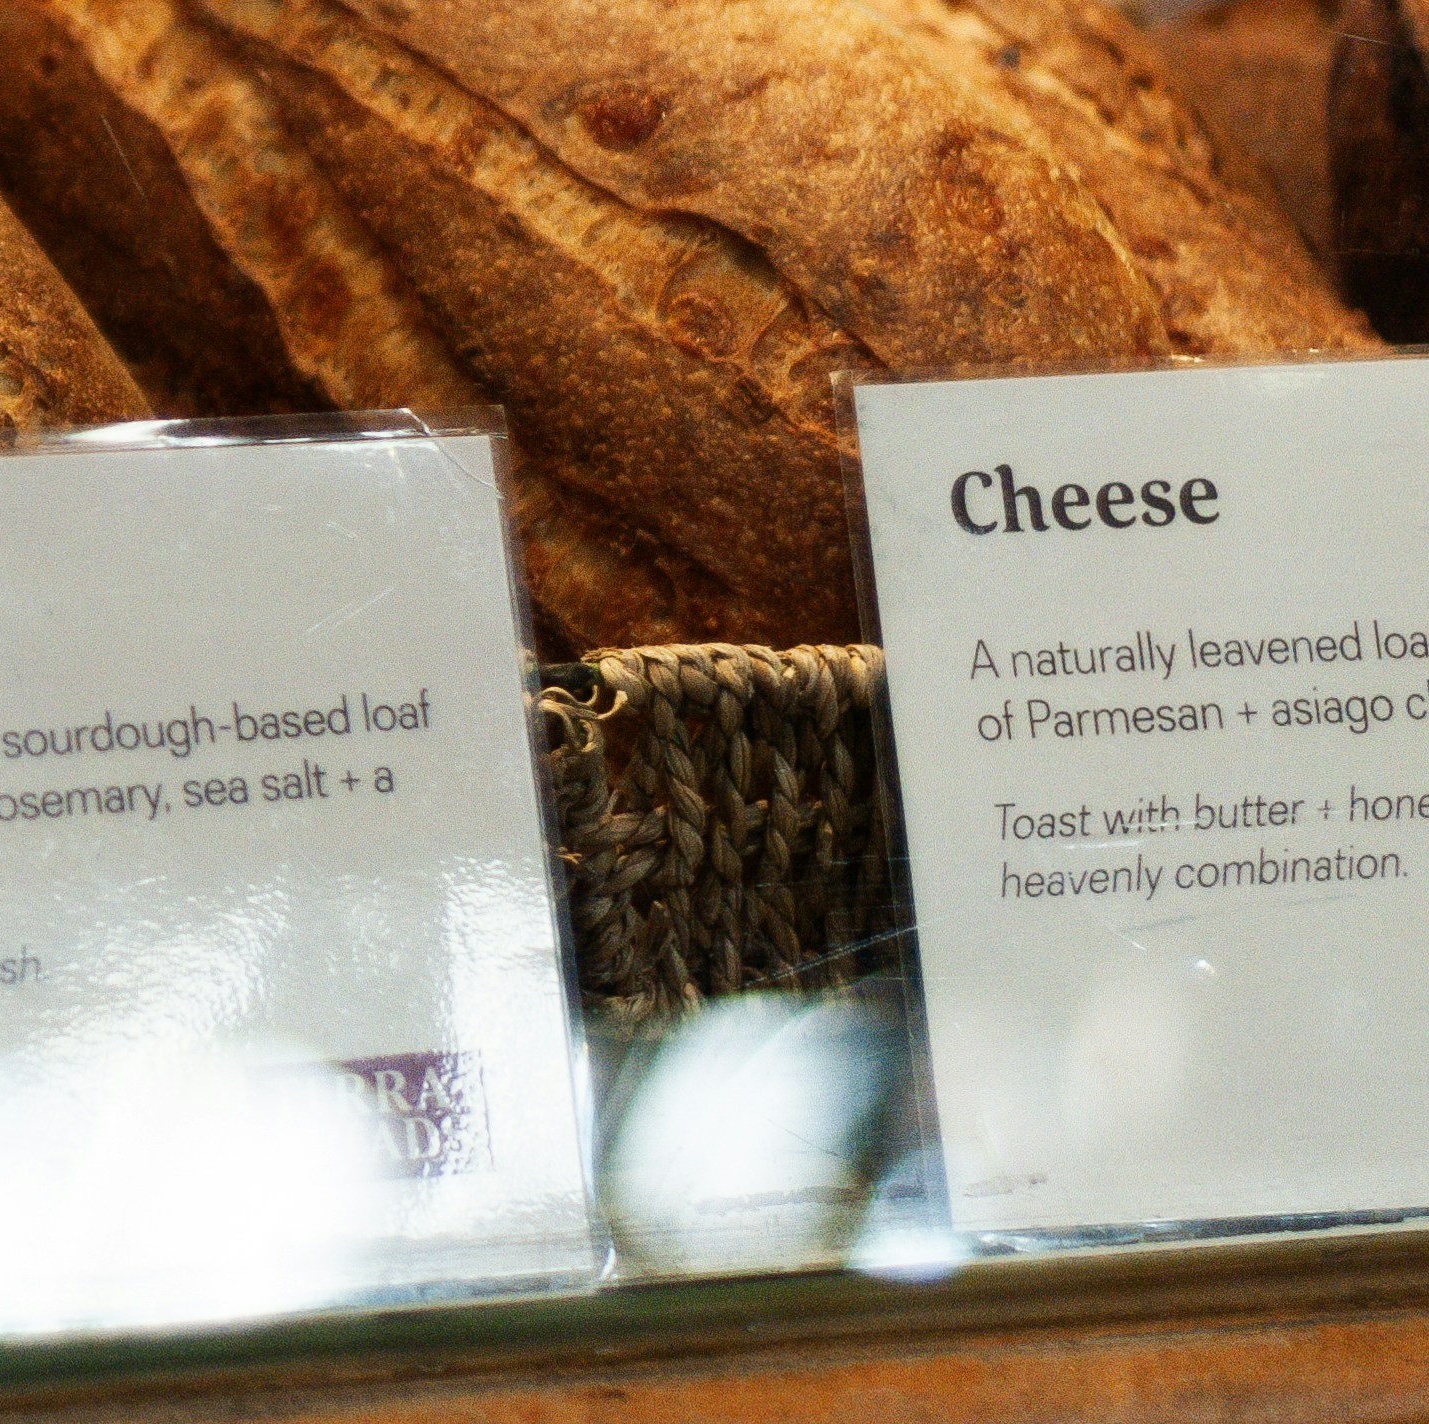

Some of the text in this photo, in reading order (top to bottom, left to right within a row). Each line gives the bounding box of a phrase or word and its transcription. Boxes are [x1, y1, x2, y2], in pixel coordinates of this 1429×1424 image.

[951, 464, 1221, 536] Cheese
[970, 619, 1429, 681] A naturally leavened loa
[1, 693, 351, 766] sourdough-based
[362, 687, 432, 734] loaf
[977, 699, 1015, 742] of
[1027, 696, 1223, 741] Parmesan
[1237, 705, 1259, 725] +
[1270, 686, 1395, 735] asiago
[183, 771, 249, 809] sea
[259, 757, 329, 804] salt
[373, 764, 396, 795] a
[994, 784, 1429, 841] Toast with butter + hone
[1001, 845, 1408, 901] heavenly combination.
